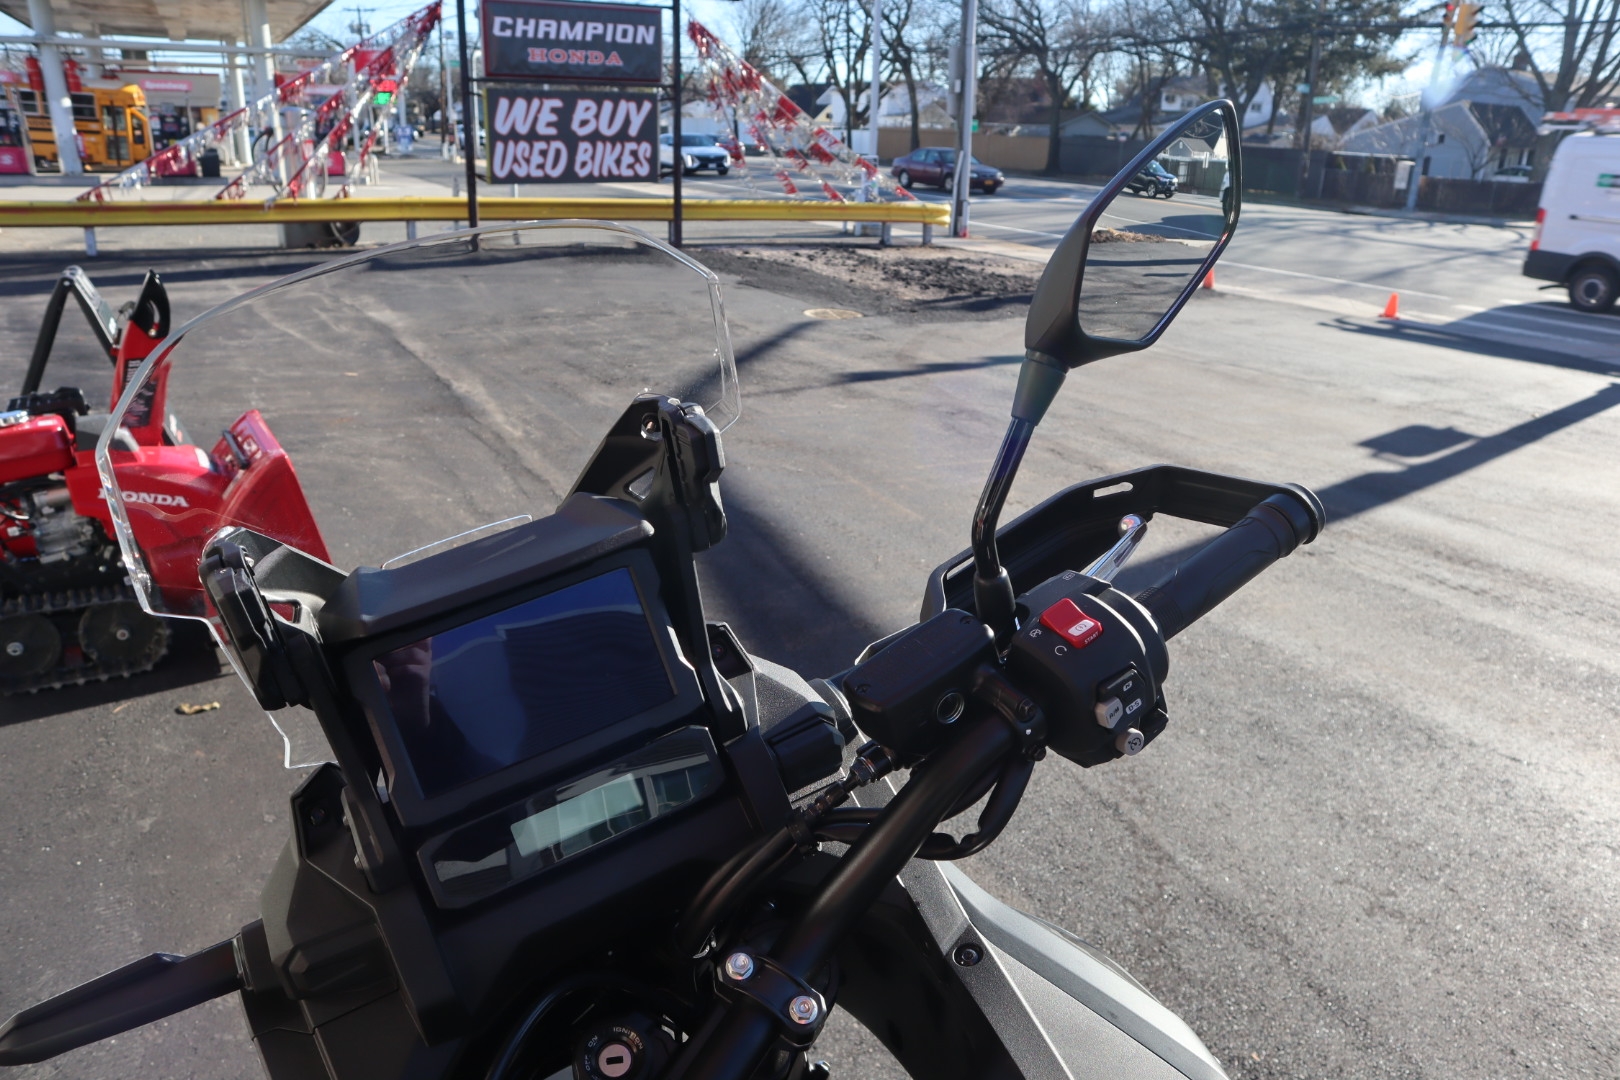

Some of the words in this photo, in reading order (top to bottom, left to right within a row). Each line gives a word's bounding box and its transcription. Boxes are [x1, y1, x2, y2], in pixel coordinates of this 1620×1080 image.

[492, 16, 656, 45] CHAMPION
[527, 47, 624, 66] HONDA
[494, 97, 564, 136] WE
[571, 98, 653, 137] BUY
[492, 139, 568, 179] USED
[574, 140, 652, 178] BIKES
[1084, 631, 1099, 645] START
[1109, 706, 1120, 719] A/M
[613, 1027, 643, 1049] IGNITION
